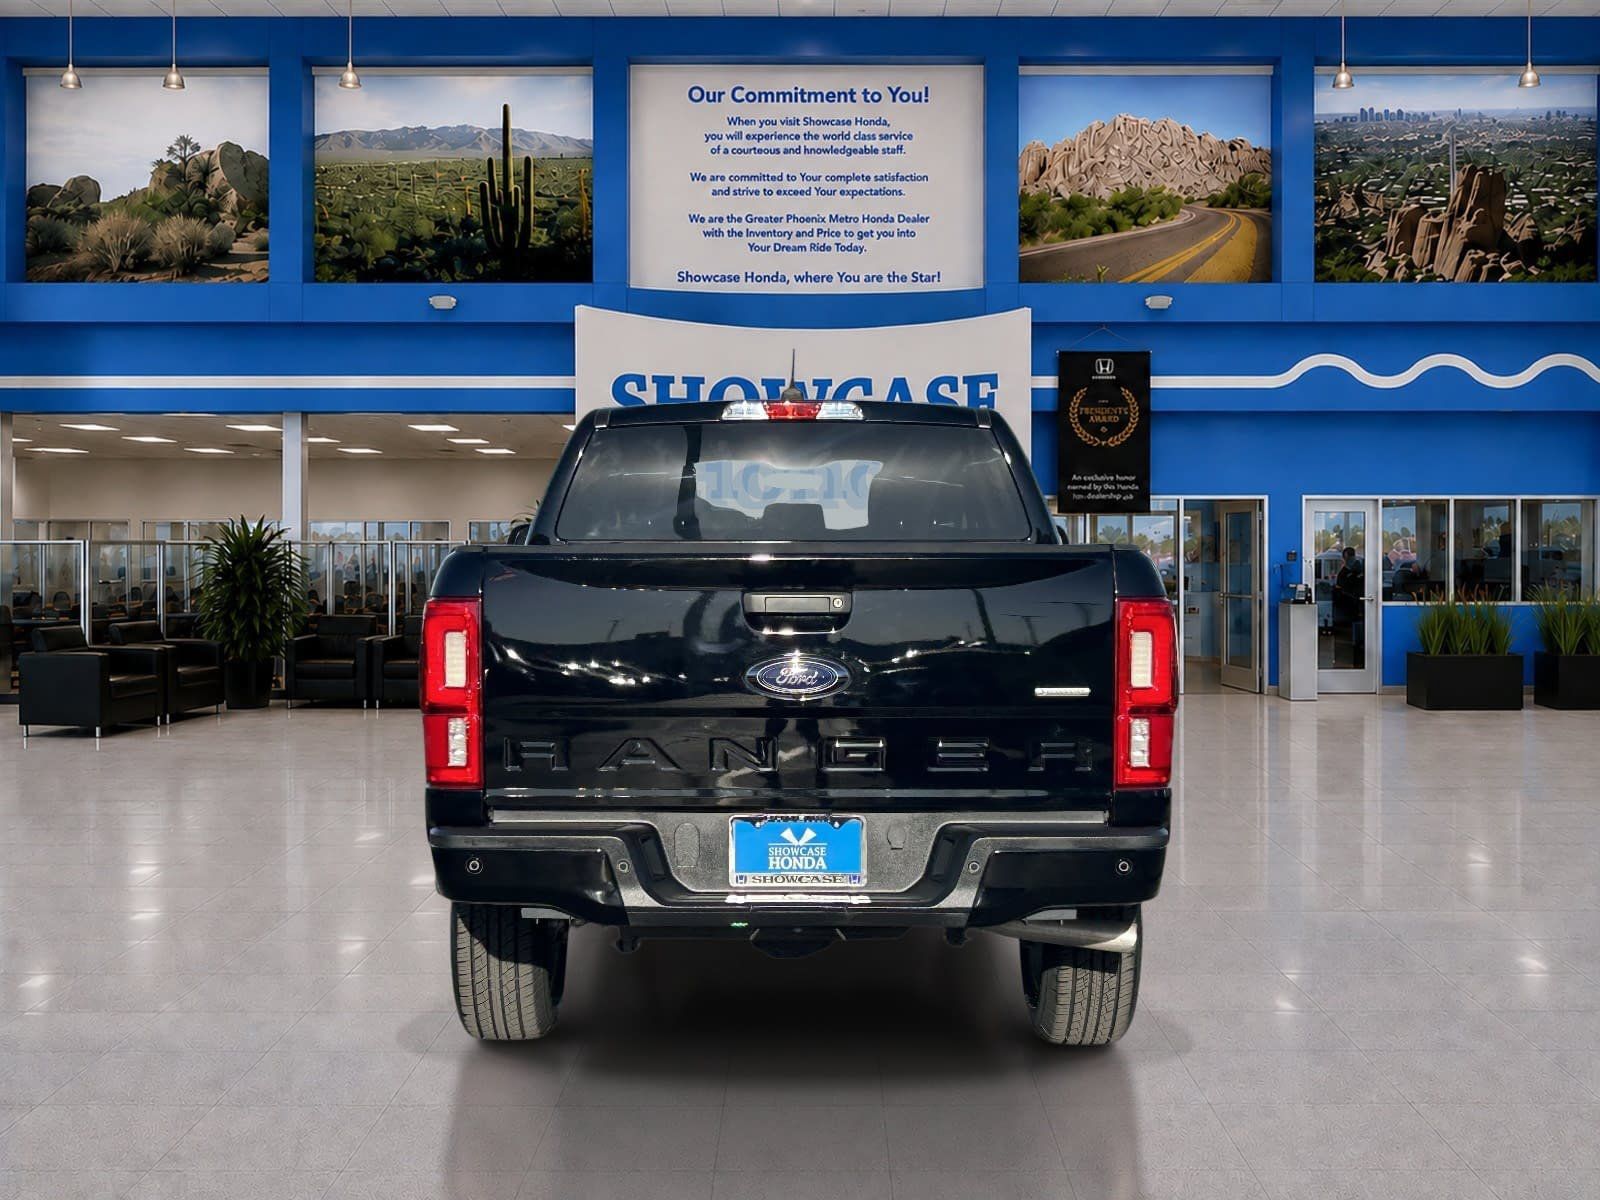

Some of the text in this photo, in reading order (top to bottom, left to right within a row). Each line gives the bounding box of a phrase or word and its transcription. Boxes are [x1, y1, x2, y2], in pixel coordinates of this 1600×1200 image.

[687, 85, 930, 104] Our Commitment to You!
[726, 115, 891, 129] When you visit Showcase Honda,
[704, 130, 914, 144] you will experience the world class service
[709, 144, 721, 155] of
[722, 147, 730, 155] a
[730, 146, 782, 156] courteous
[782, 144, 802, 155] and
[881, 144, 906, 155] staff.
[689, 171, 929, 185] We are committed to Your complete satisfaction
[711, 185, 906, 200] and strive to exceed Your expectations.
[688, 213, 931, 225] We are the Greater Phoenix Metro Honda Dealer
[702, 227, 917, 241] with the Inventory and Price to get you into
[747, 242, 868, 255] Your Dream Ride Today.
[676, 270, 941, 286] Showcase Honda, where You are the Star!
[776, 666, 819, 686] Ford
[503, 736, 1093, 772] RANGER
[767, 846, 828, 857] SHOWCASE
[767, 856, 828, 870] HONDA
[751, 874, 845, 884] SHOWCASE
